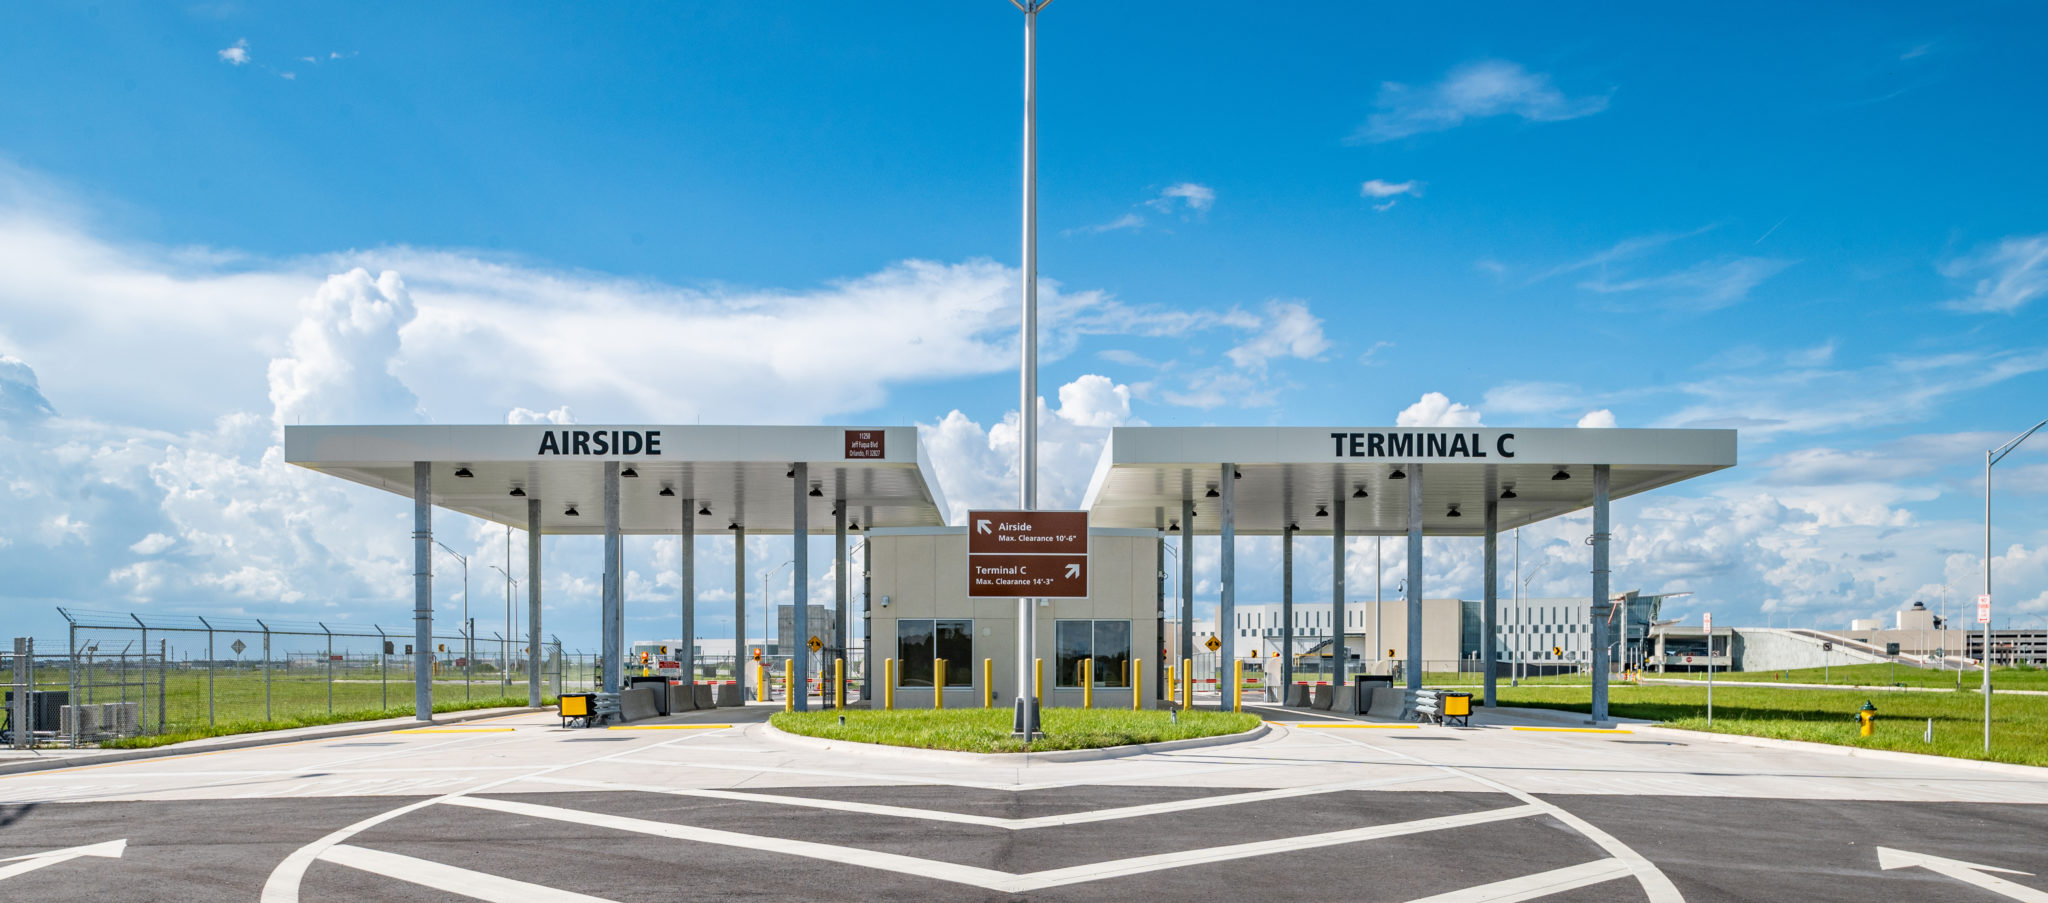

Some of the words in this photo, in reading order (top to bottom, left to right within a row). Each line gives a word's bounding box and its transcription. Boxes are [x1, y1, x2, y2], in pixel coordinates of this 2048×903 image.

[538, 431, 661, 455] AIRSIDE
[1331, 433, 1487, 457] TERMINAL
[1496, 433, 1515, 458] C
[998, 522, 1032, 531] Airside
[975, 566, 1017, 575] Terminal
[1020, 566, 1027, 575] C
